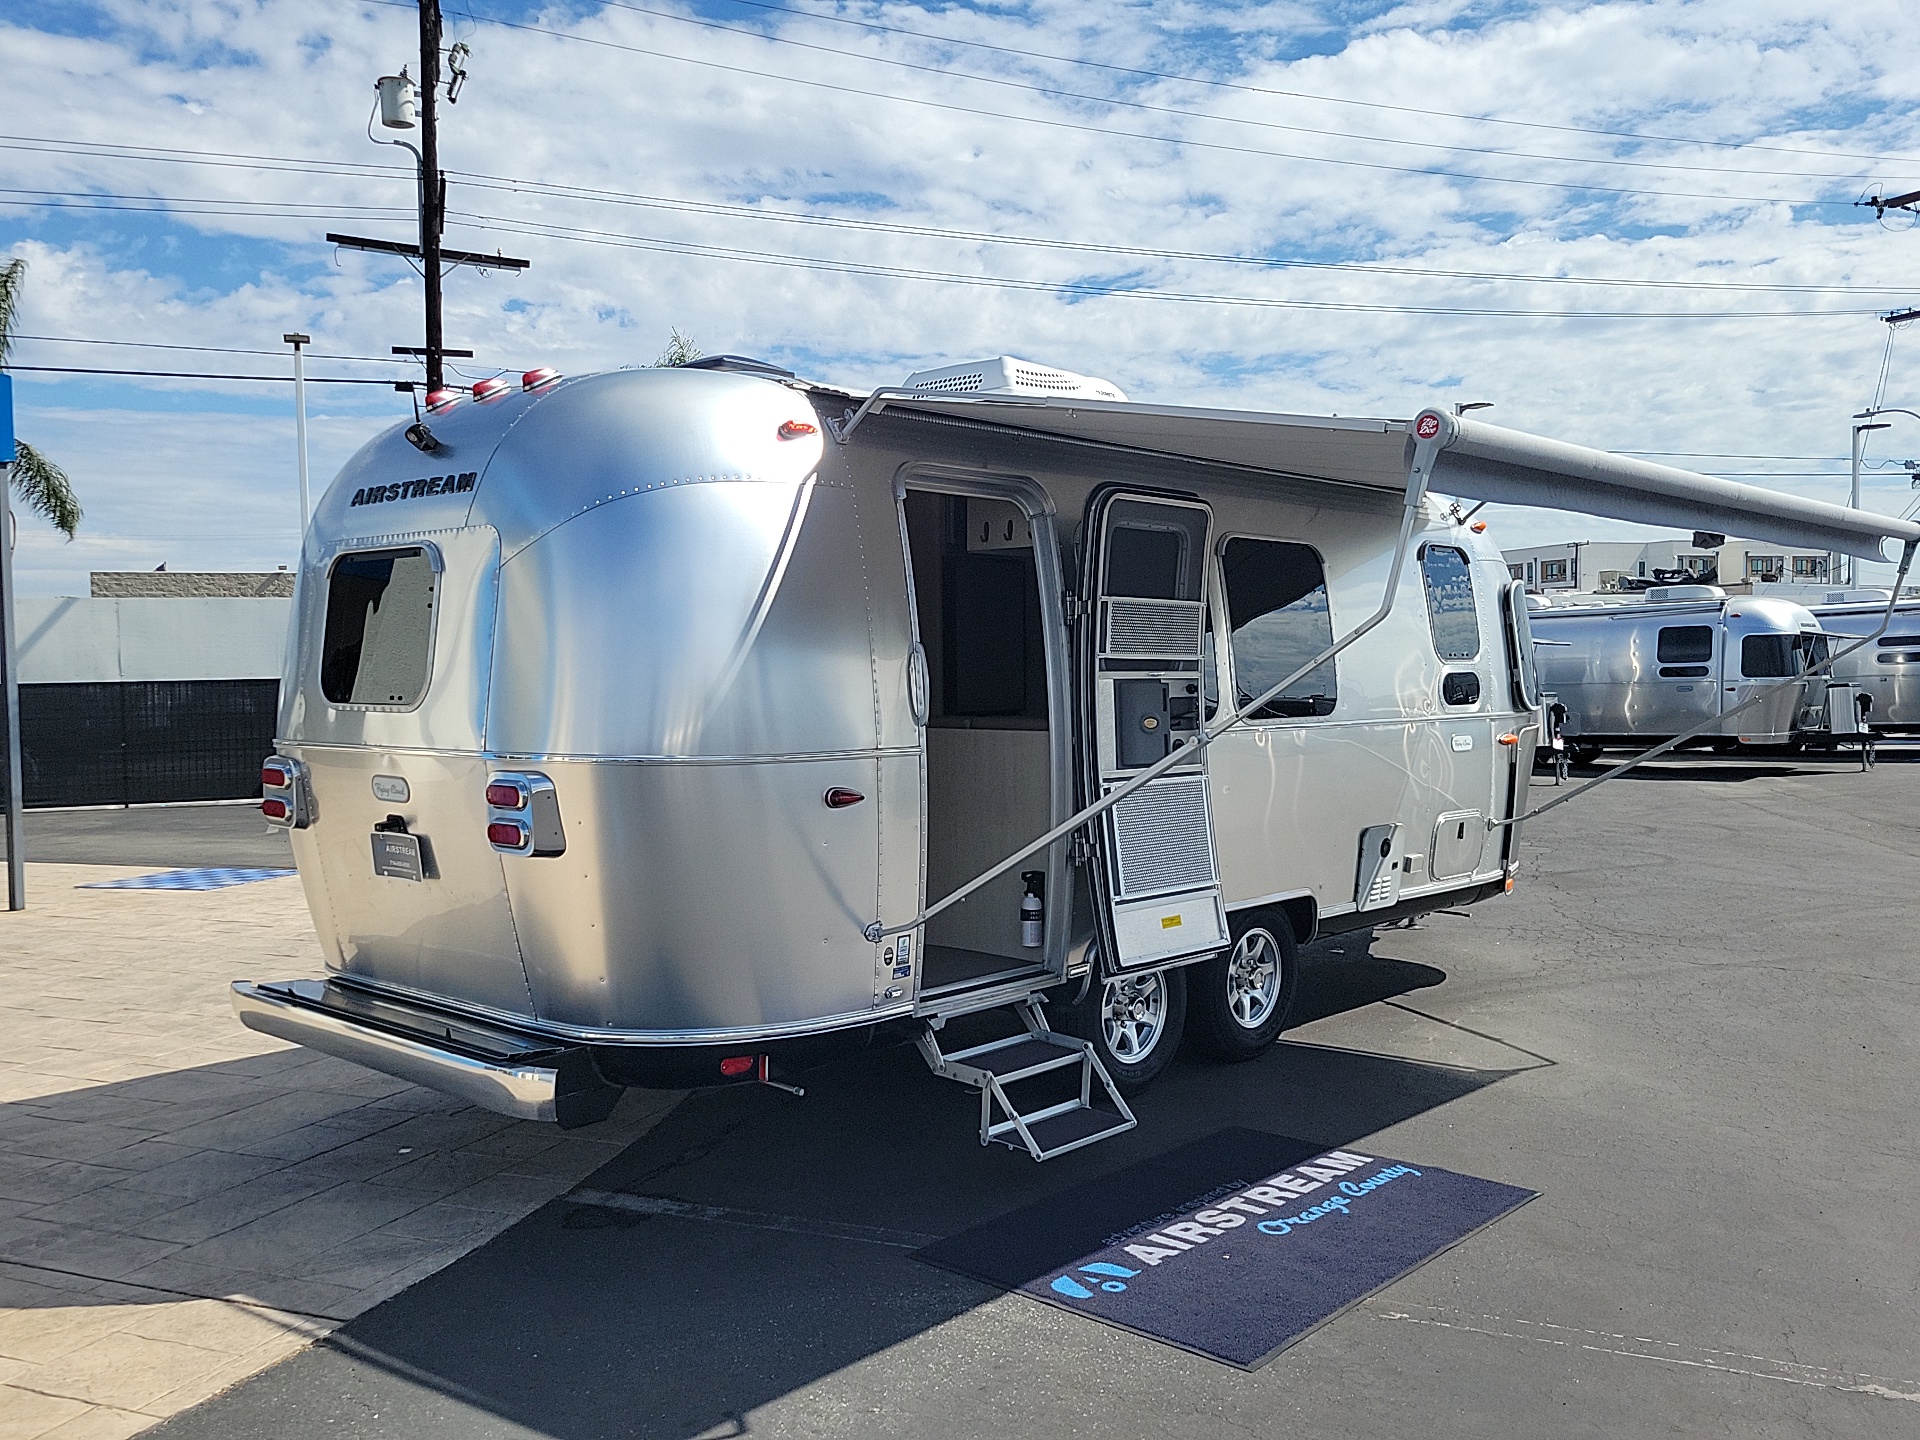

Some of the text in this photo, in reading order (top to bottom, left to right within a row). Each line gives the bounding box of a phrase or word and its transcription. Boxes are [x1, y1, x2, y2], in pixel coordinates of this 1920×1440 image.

[1421, 417, 1438, 428] Zip
[350, 471, 478, 507] AIRSTREAM
[1123, 1151, 1375, 1266] AIRSTREAM
[1257, 1164, 1423, 1235] Orange County
